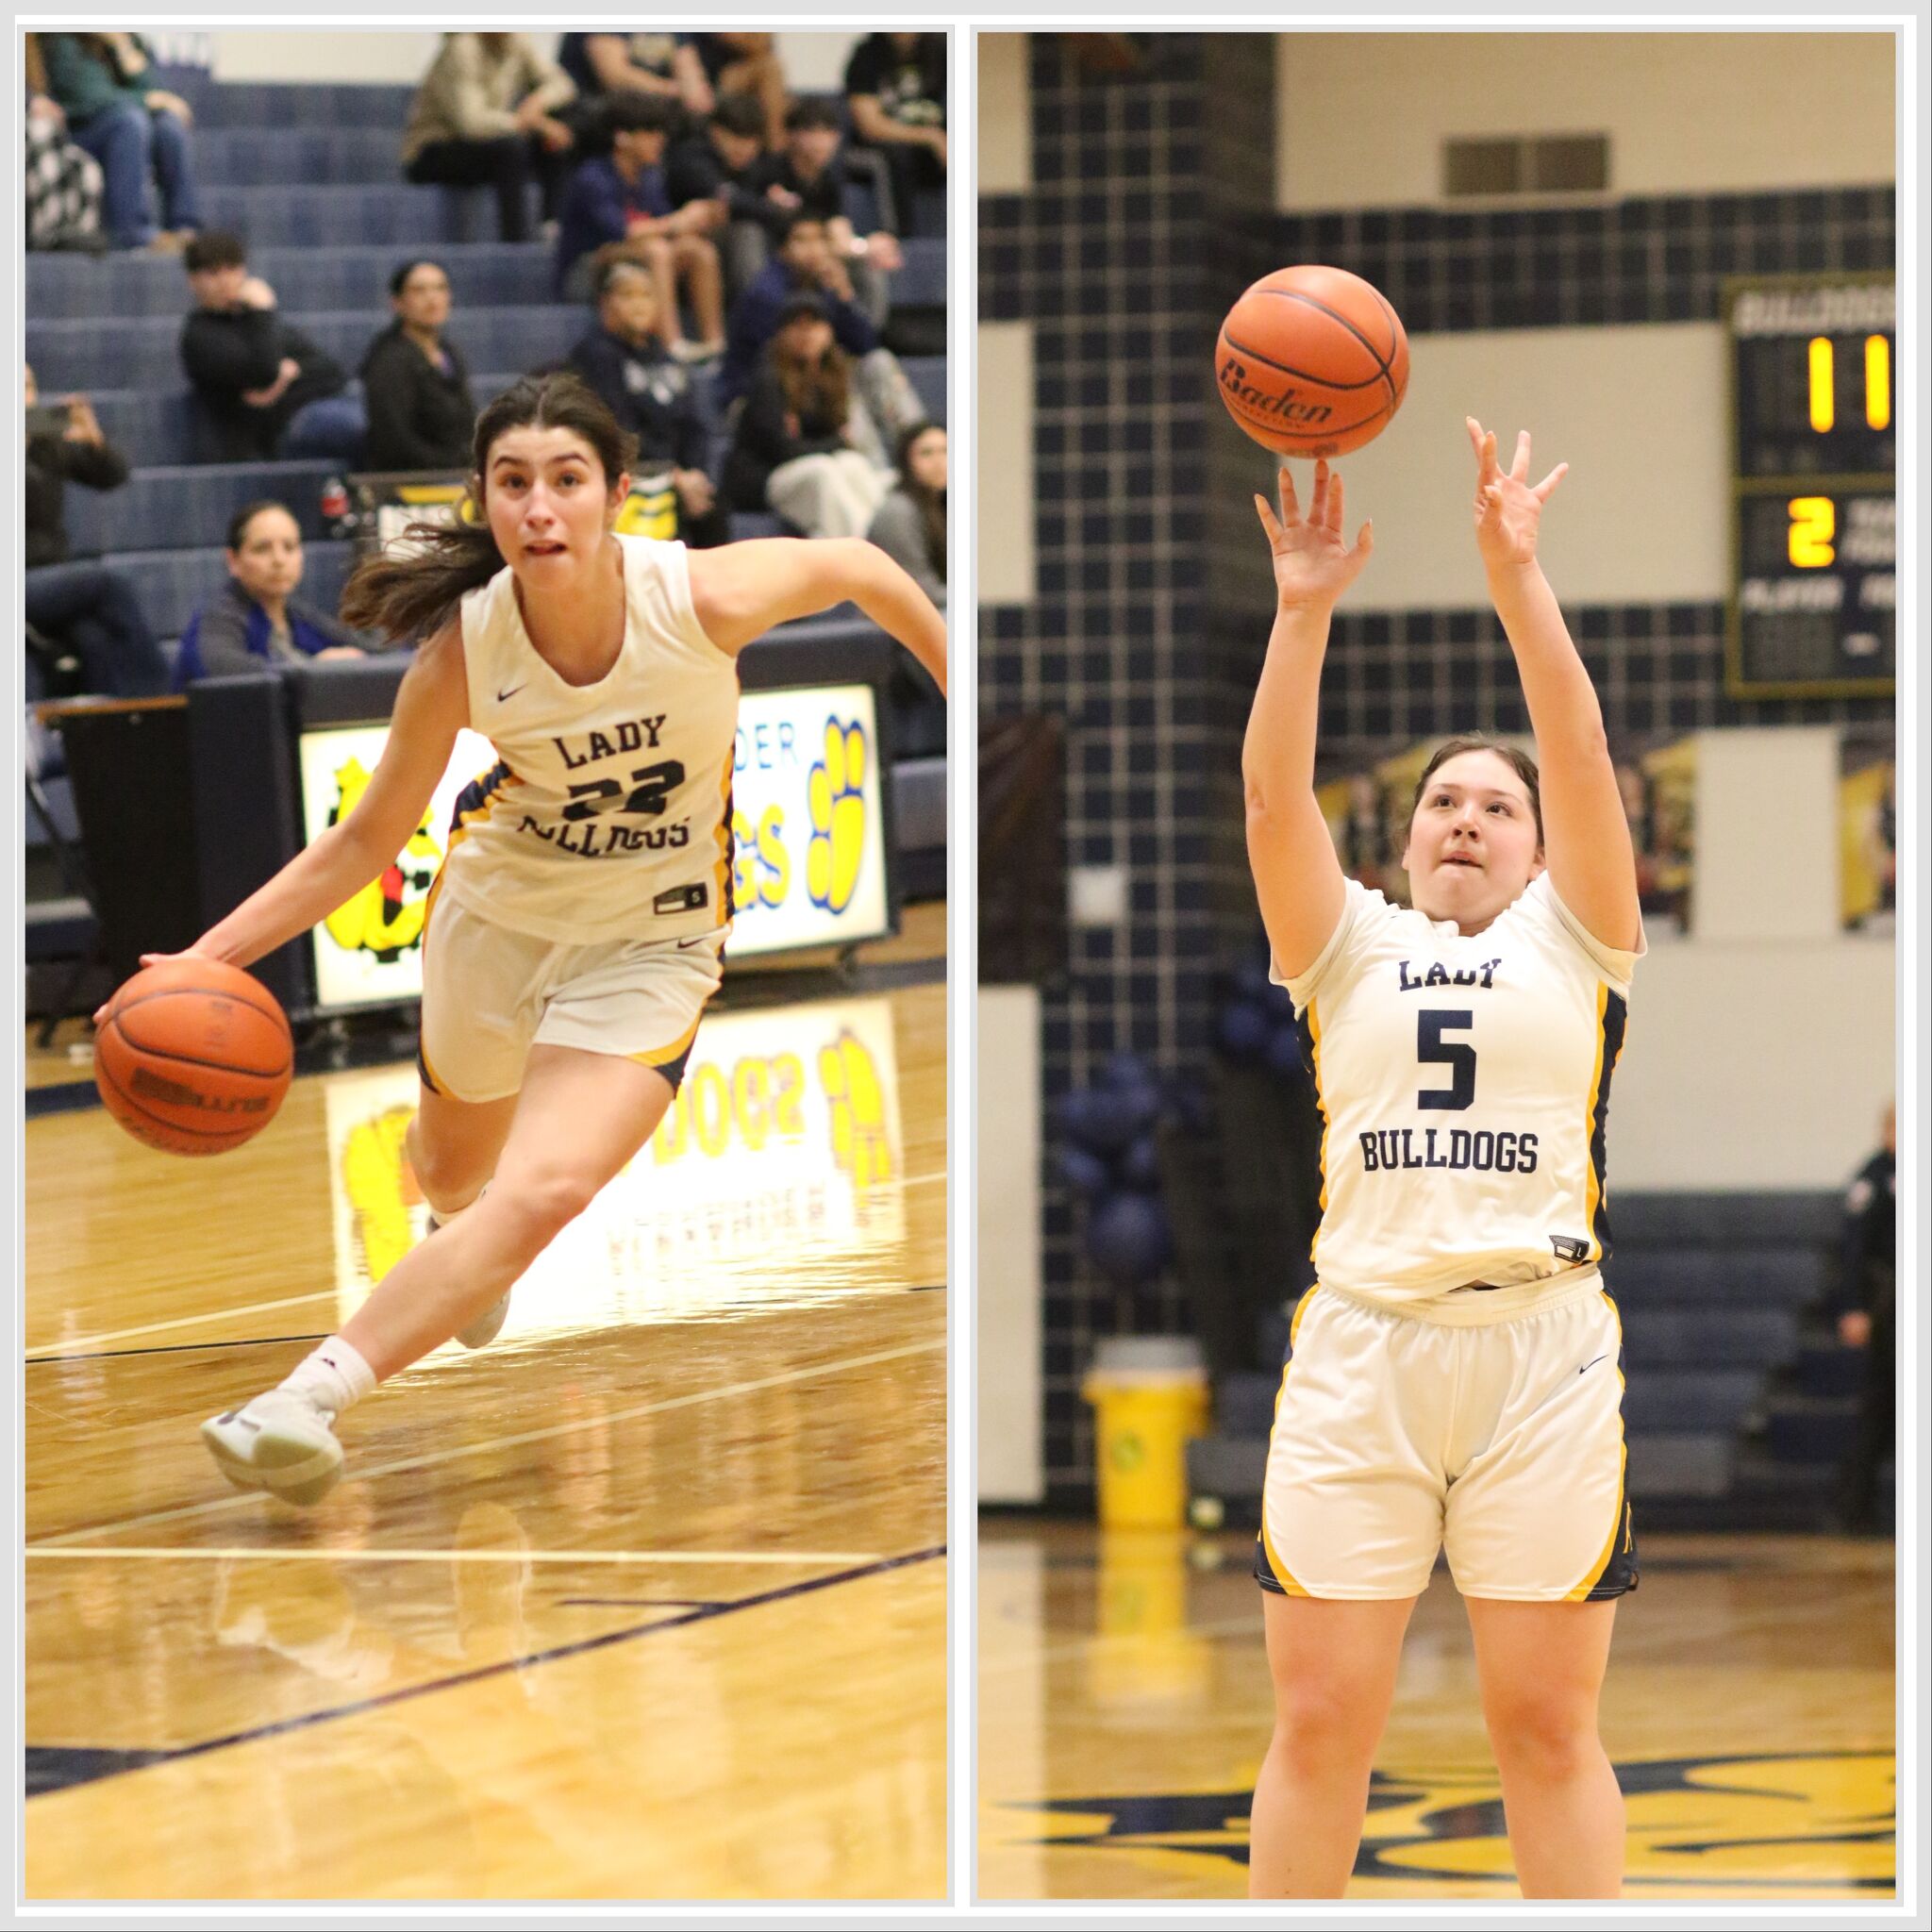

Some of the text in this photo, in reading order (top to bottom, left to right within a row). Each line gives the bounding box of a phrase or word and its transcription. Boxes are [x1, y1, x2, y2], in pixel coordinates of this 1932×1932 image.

[1221, 358, 1332, 424] Baden
[1808, 334, 1890, 433] 11
[1788, 496, 1836, 568] 2
[552, 713, 666, 770] LADY
[561, 759, 685, 822] 22
[691, 891, 701, 904] S
[1399, 958, 1502, 991] LADY
[1417, 1009, 1477, 1110] 5
[1358, 1128, 1539, 1174] BULLDOGS
